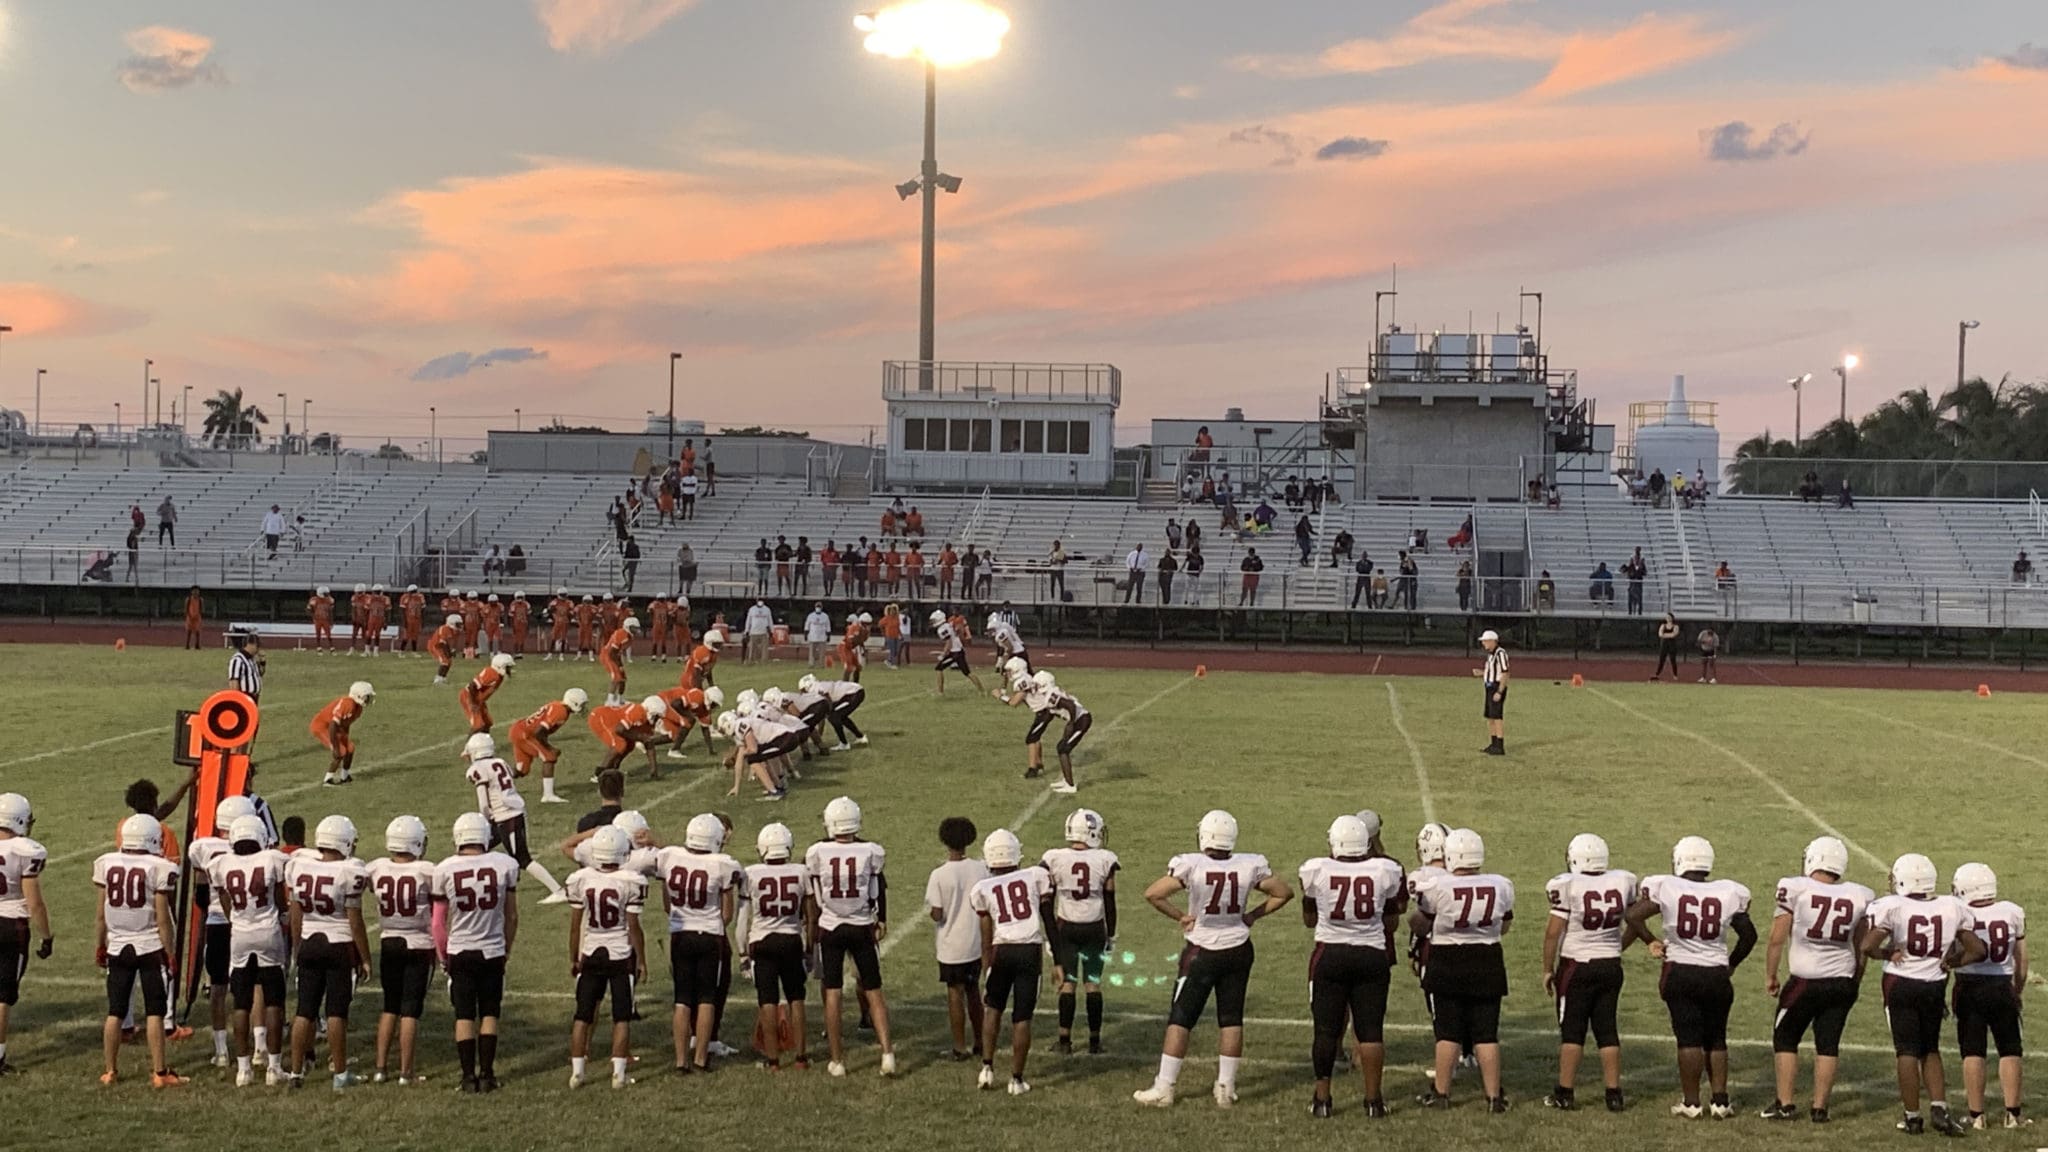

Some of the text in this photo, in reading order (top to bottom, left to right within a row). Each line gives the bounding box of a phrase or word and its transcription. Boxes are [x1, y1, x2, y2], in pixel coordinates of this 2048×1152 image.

[492, 762, 512, 791] 2
[107, 866, 147, 909] 80
[226, 867, 268, 910] 84
[296, 874, 336, 915] 35
[377, 876, 417, 917] 30
[453, 867, 499, 912] 53
[668, 866, 709, 909] 90
[759, 876, 799, 917] 25
[829, 857, 860, 898] 11
[1072, 862, 1090, 900] 3
[1205, 871, 1241, 915] 71
[1330, 876, 1375, 920] 78
[585, 888, 620, 929] 16
[992, 879, 1032, 924] 18
[1453, 886, 1496, 928] 77
[1583, 889, 1624, 930] 62
[1676, 895, 1722, 940] 68
[1806, 895, 1853, 942] 72
[1907, 915, 1943, 958] 61
